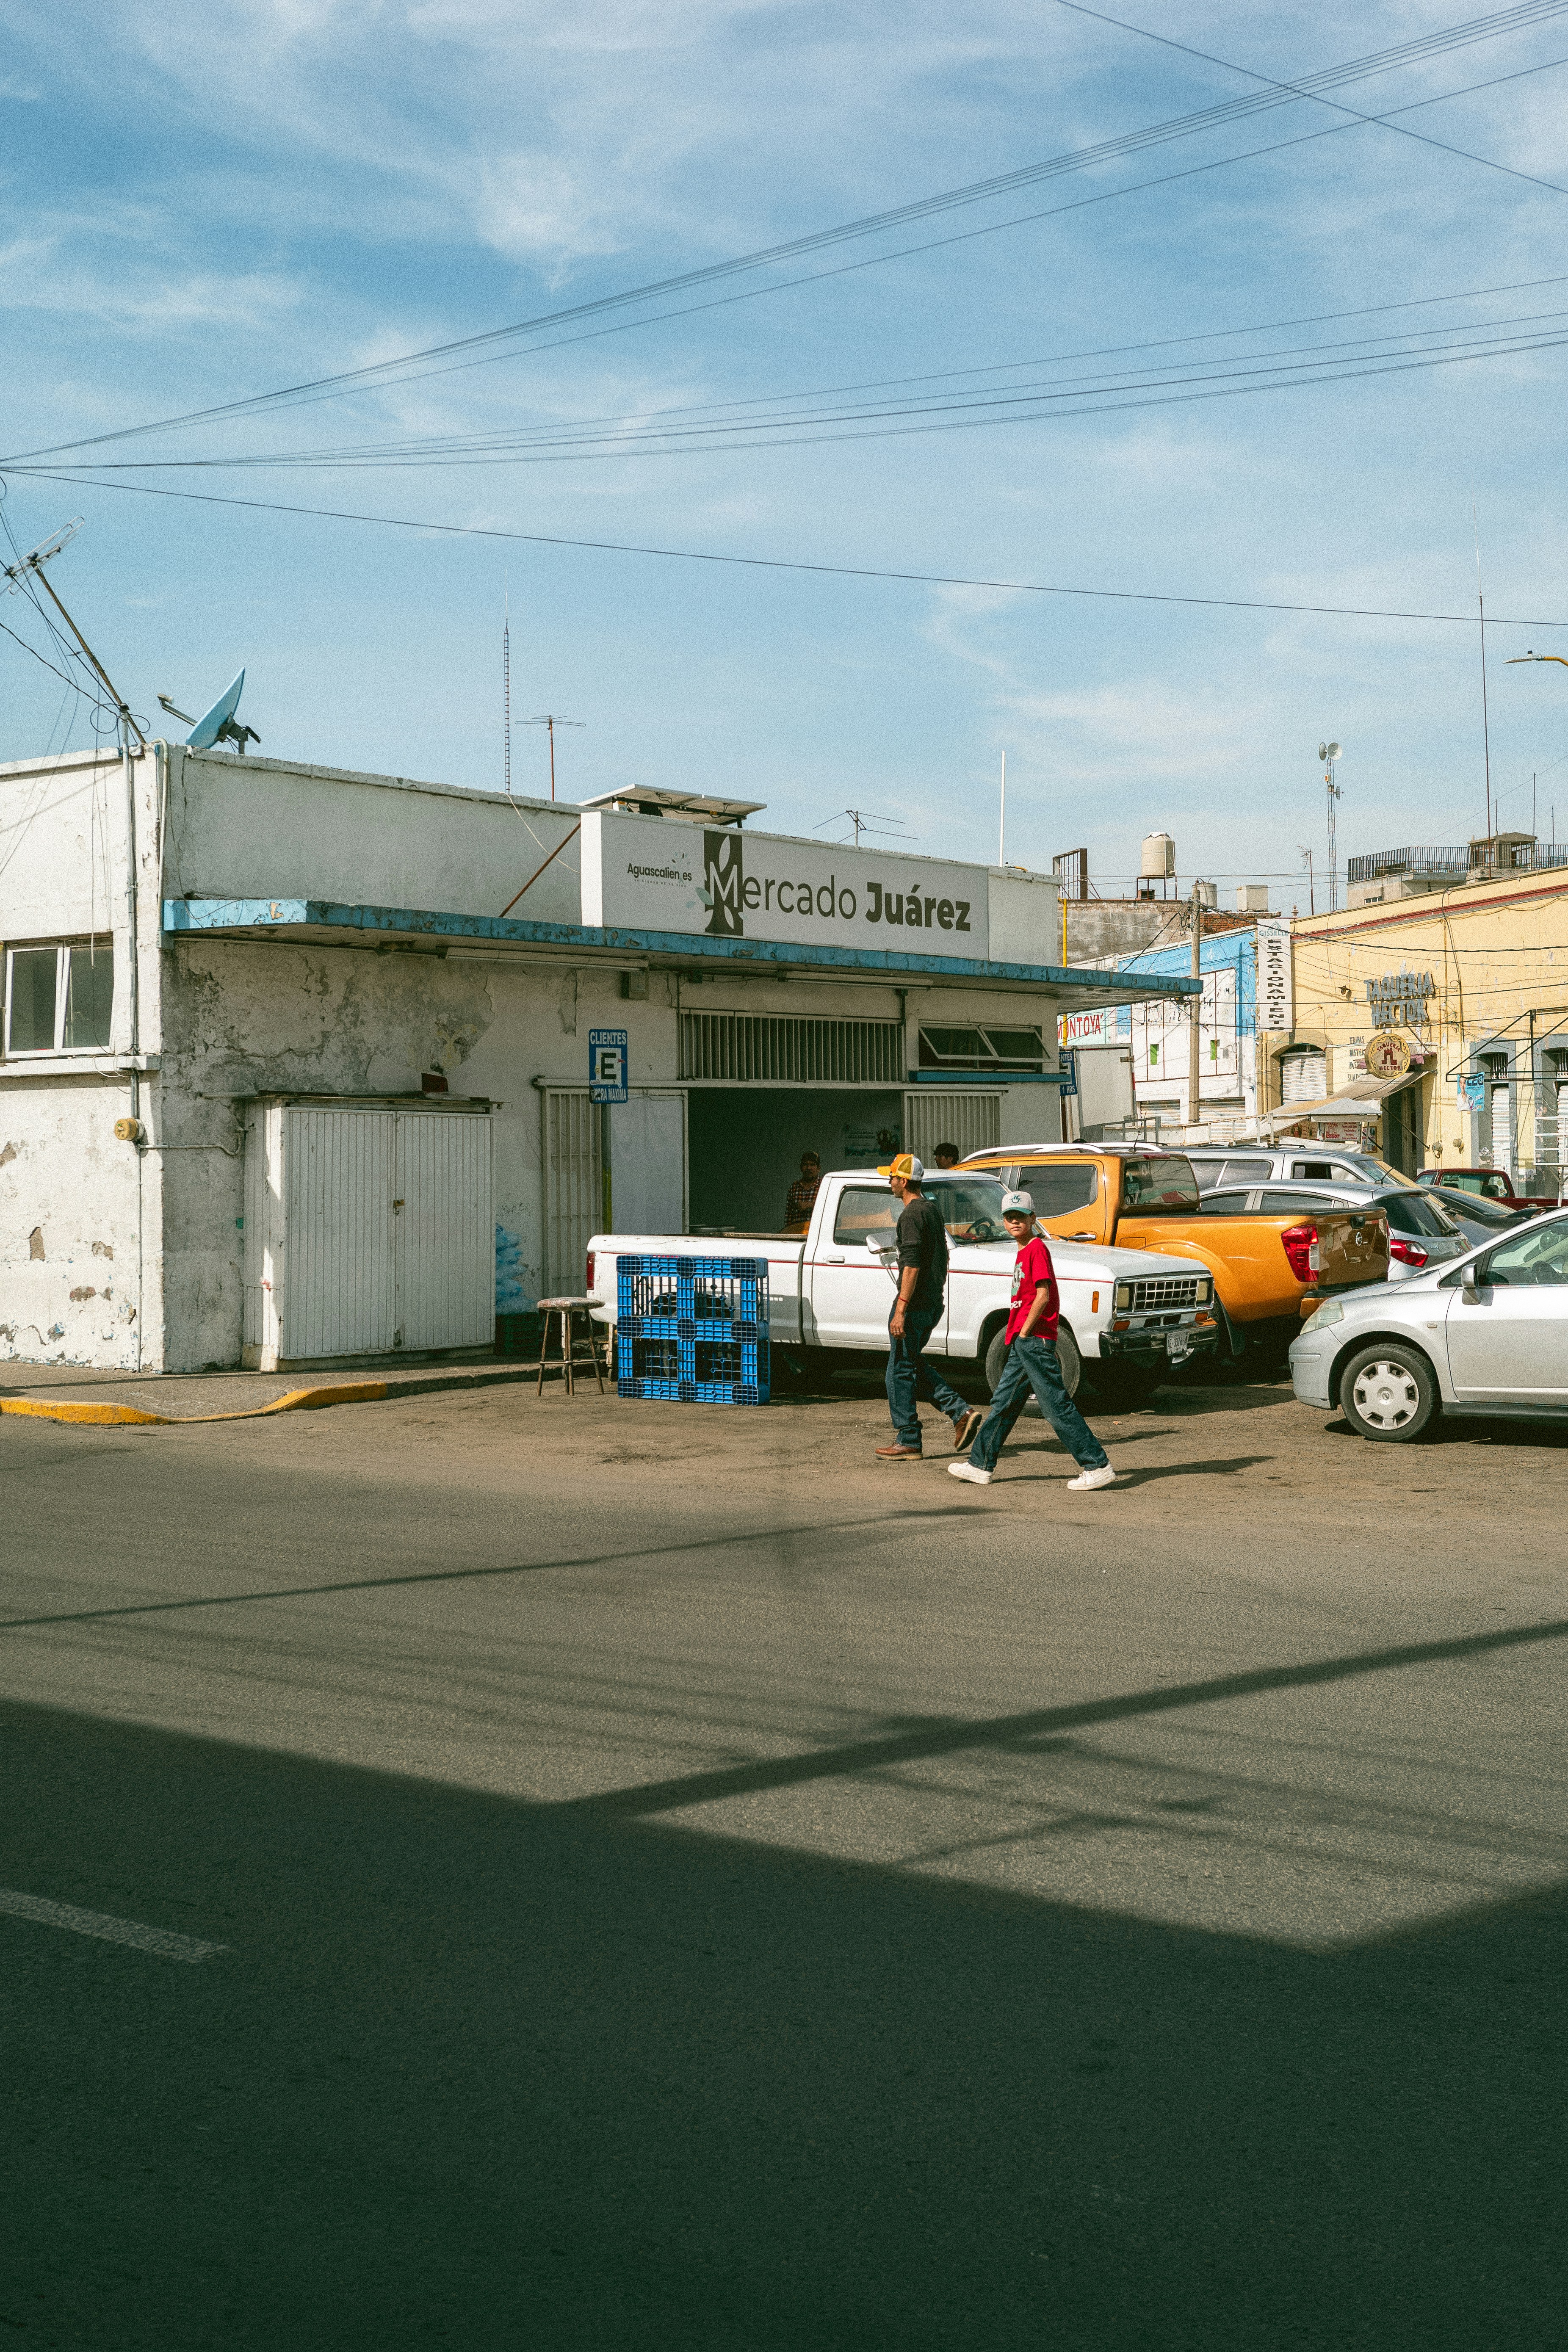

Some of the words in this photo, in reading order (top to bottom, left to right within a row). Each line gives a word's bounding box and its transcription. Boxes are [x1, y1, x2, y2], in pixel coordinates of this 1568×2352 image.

[710, 862, 857, 919] Mercado
[865, 882, 971, 931] Juárez
[1267, 939, 1285, 1031] ESTACIONAMIENTO
[1364, 971, 1435, 1001] TAQUERIA
[1372, 998, 1428, 1026] HECTOR
[590, 1032, 627, 1045] CLIENTES
[1350, 1036, 1364, 1044] TRIPAS
[1377, 1042, 1400, 1052] TAQUERIA
[601, 1052, 617, 1080] E
[1067, 1085, 1076, 1094] HRS
